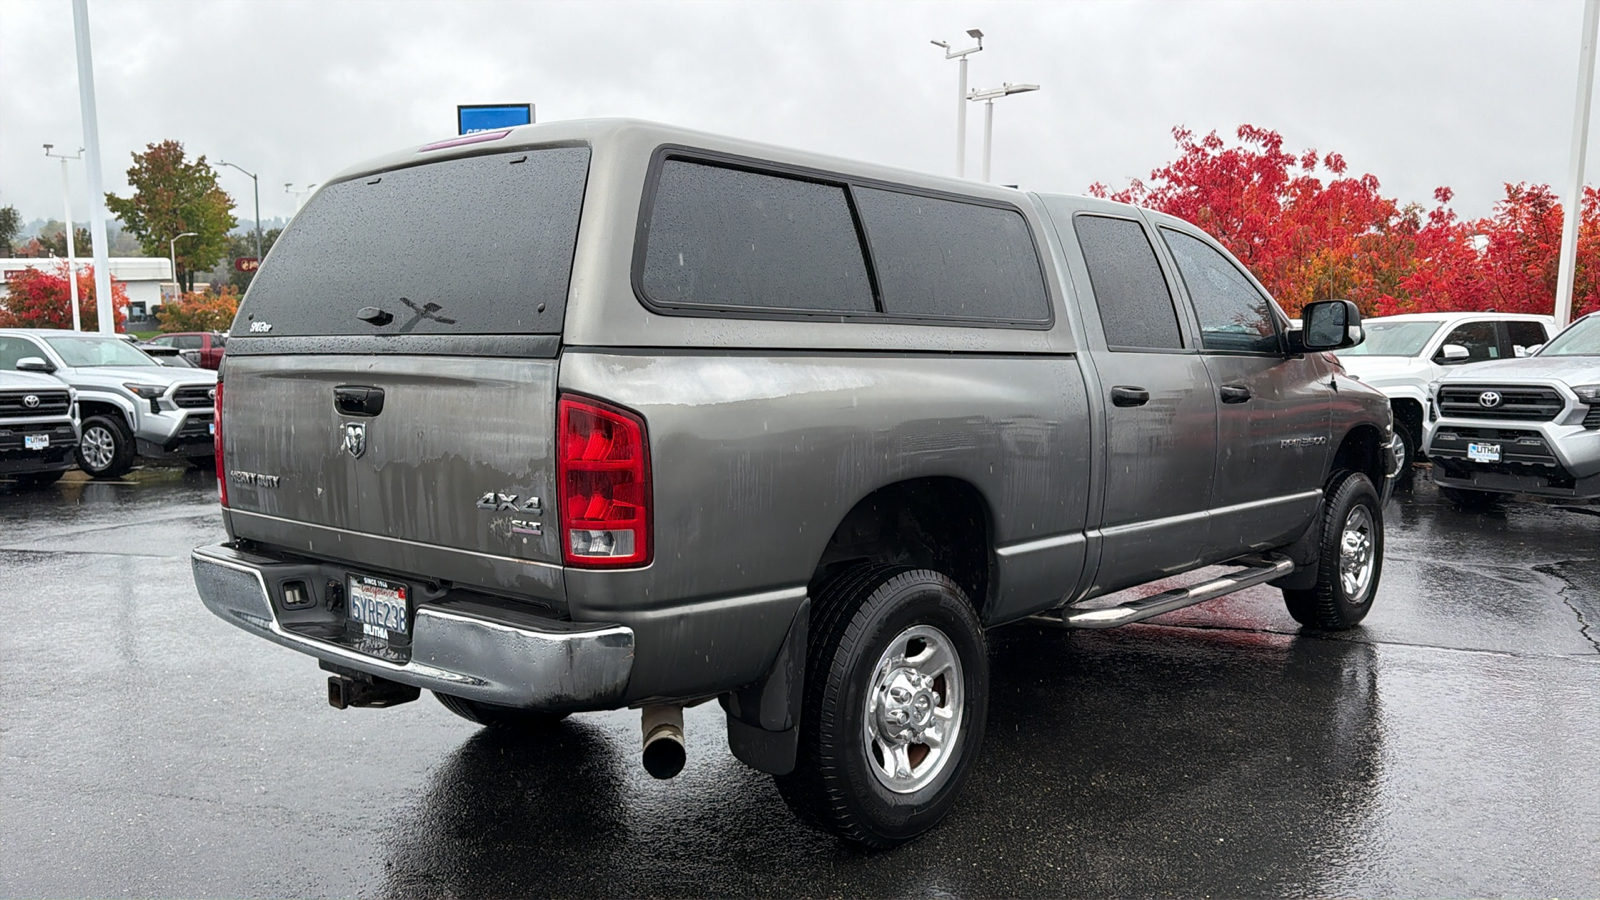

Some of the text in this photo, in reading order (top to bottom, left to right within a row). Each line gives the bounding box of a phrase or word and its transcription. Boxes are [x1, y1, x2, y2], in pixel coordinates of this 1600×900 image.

[1476, 445, 1500, 455] LITHIA
[230, 470, 280, 488] HEAVY DUTY
[511, 519, 542, 532] SLT
[353, 594, 406, 633] 5YRE238
